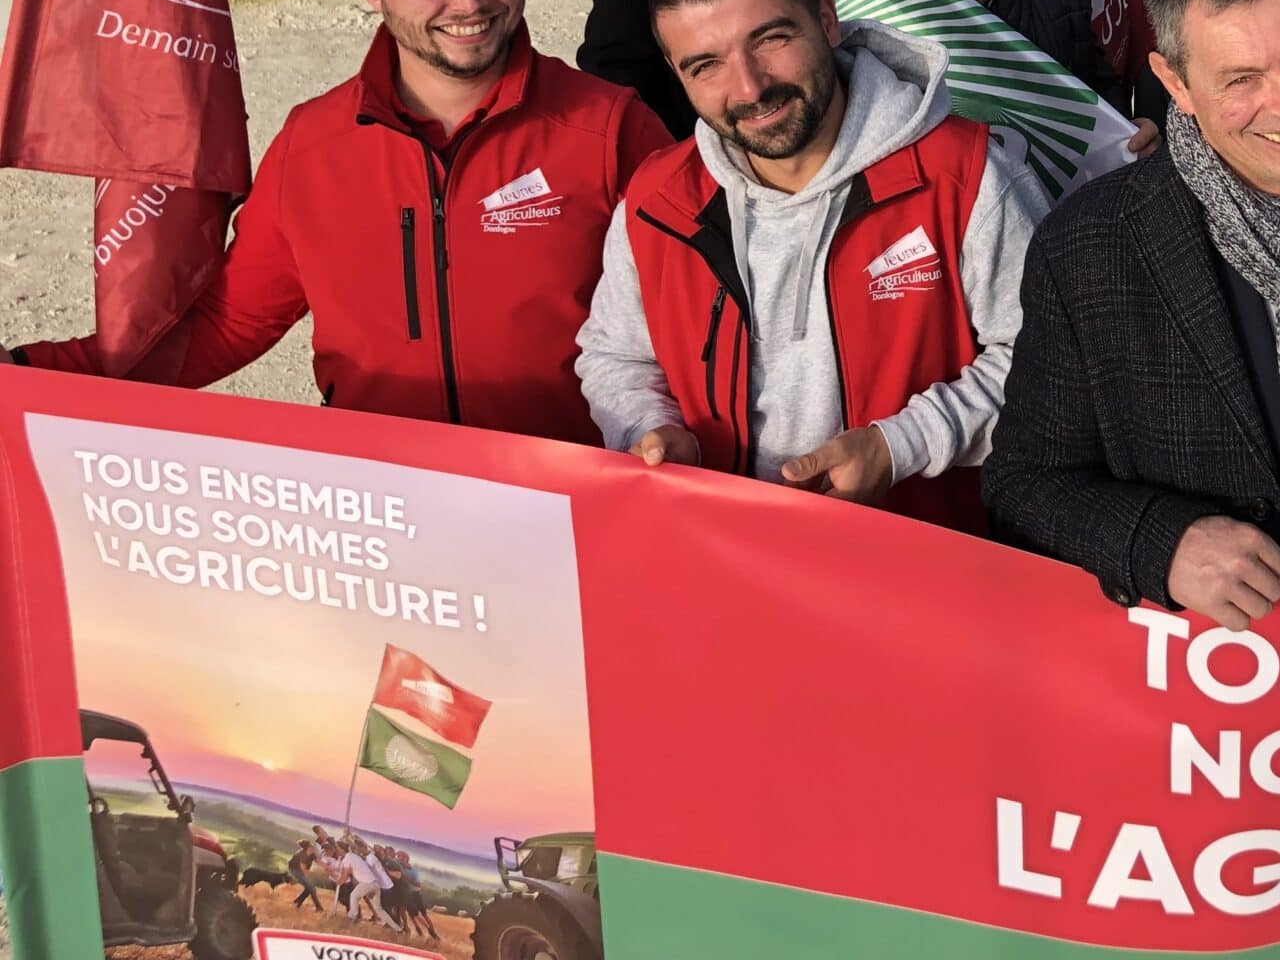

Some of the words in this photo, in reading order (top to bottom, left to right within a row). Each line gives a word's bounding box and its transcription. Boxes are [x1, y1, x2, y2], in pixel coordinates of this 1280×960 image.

[96, 9, 217, 64] Demain
[500, 182, 543, 204] Jeunes
[490, 206, 561, 224] Agriculteurs
[883, 242, 927, 268] Jeunes
[74, 450, 189, 495] TOUS
[200, 465, 417, 539] ENSEMBLE,
[82, 491, 200, 539] NOUS
[211, 510, 389, 571] SOMMES
[93, 530, 461, 628] L'AGRICULTURE
[473, 595, 488, 632] !
[311, 945, 399, 960] VOTO
